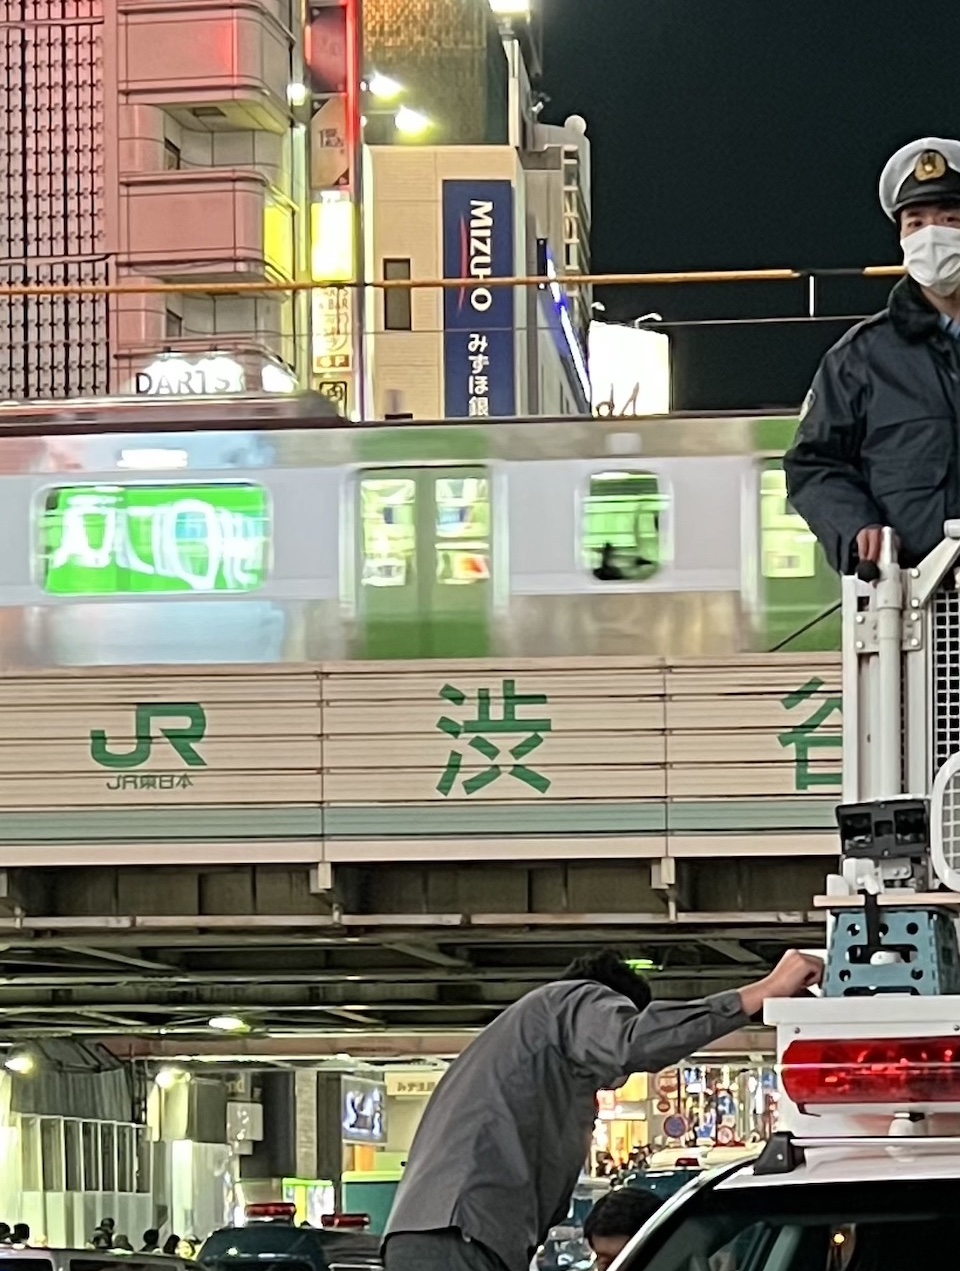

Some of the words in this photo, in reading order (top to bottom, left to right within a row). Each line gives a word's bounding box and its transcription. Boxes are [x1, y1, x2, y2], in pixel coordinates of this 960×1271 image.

[90, 702, 208, 769] JR
[106, 773, 194, 790] JR東日本
